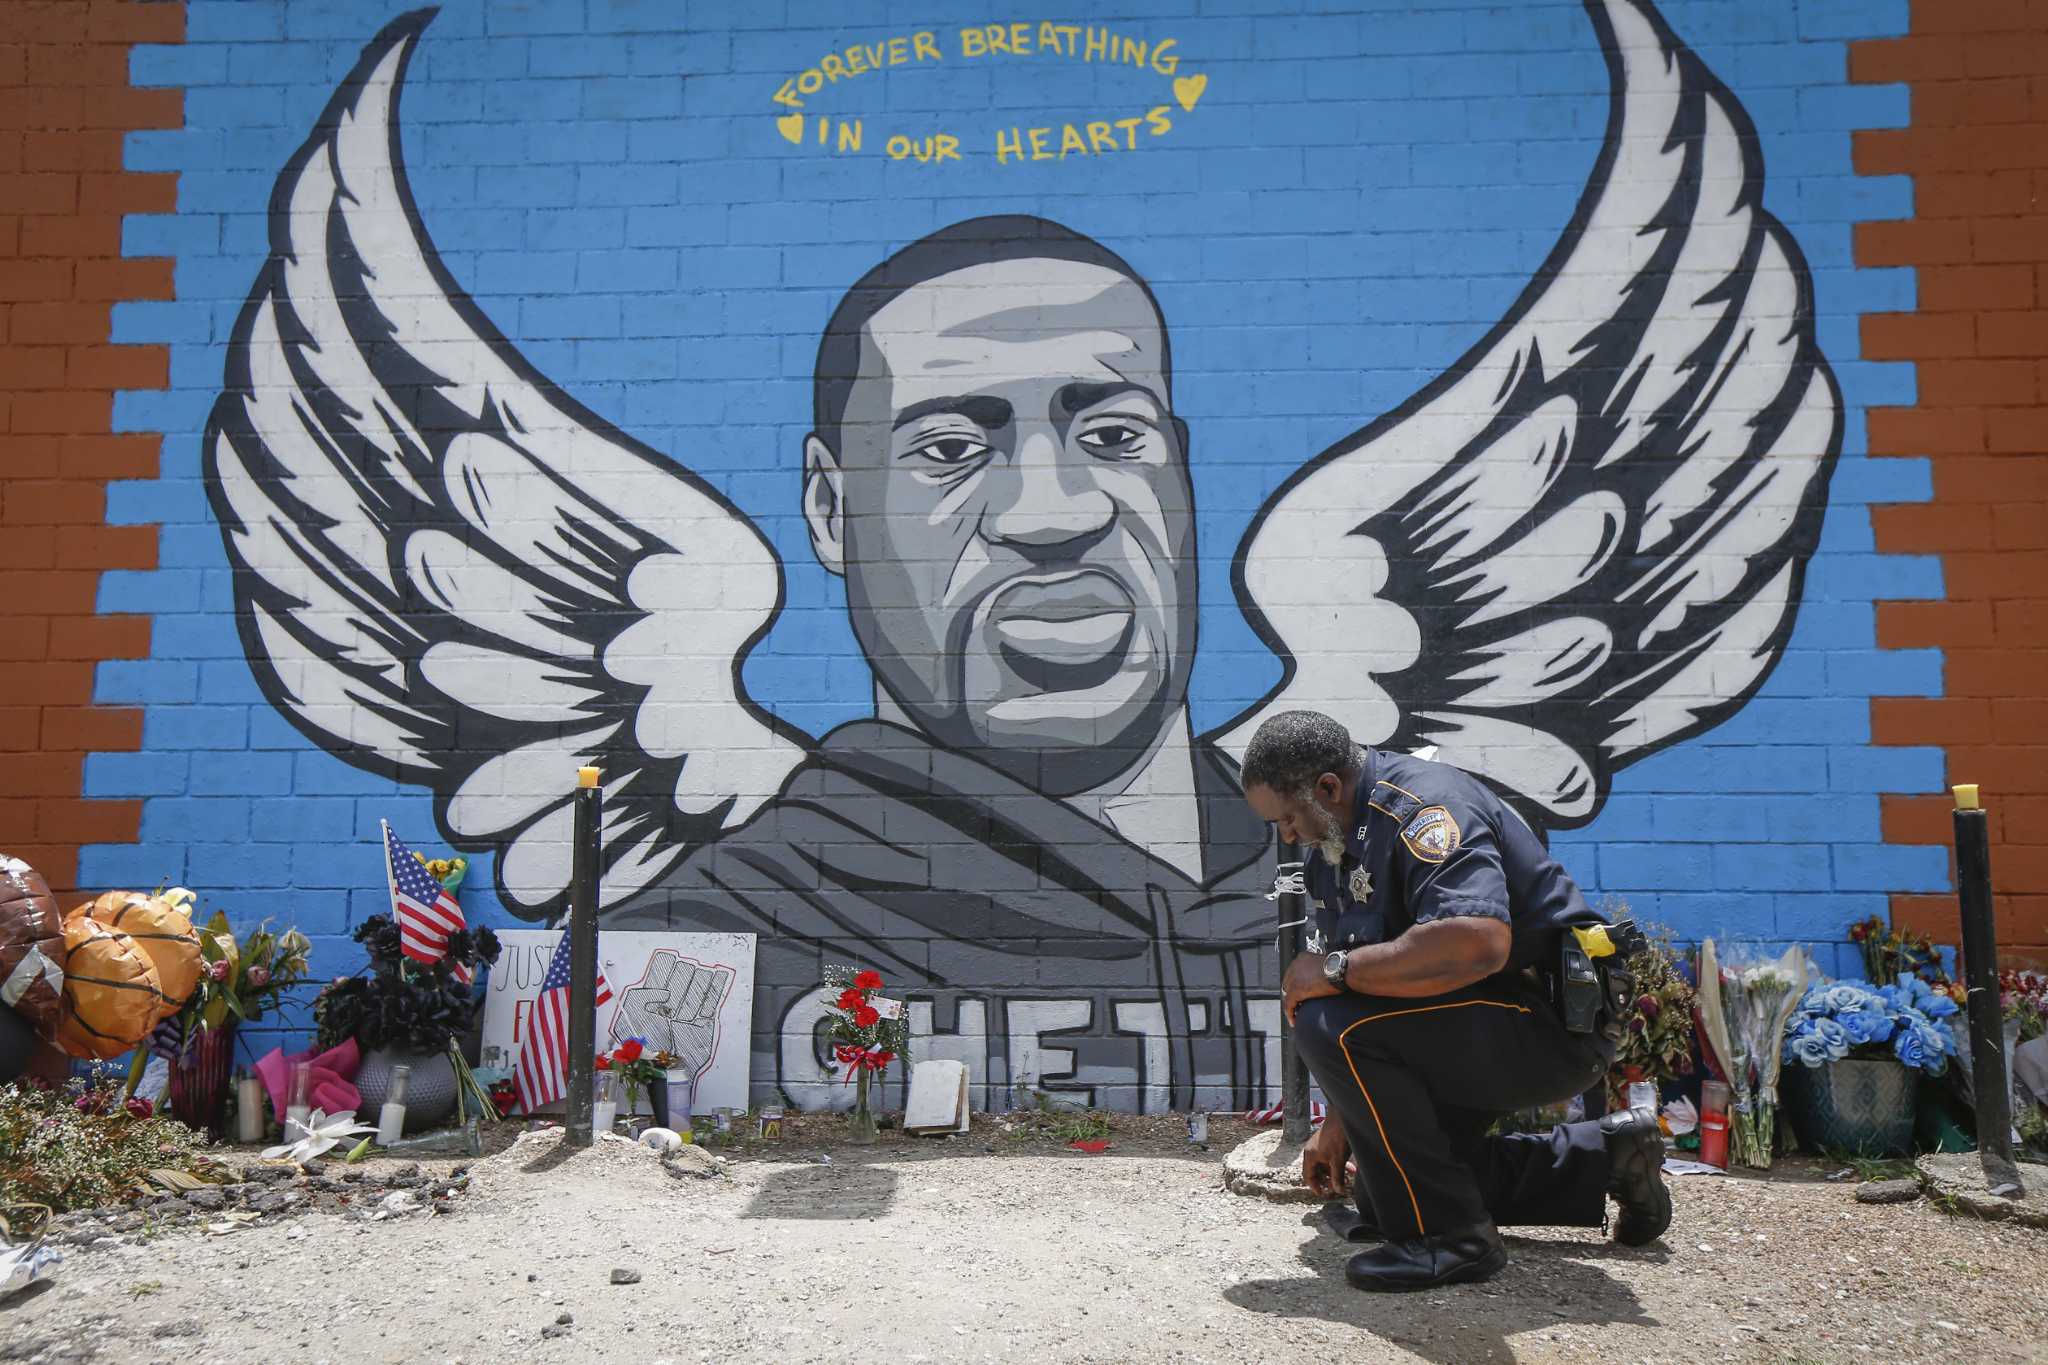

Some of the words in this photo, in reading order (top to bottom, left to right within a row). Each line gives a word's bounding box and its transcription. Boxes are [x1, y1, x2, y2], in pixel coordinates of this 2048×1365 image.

[773, 31, 941, 107] FOREVER
[961, 21, 1180, 75] BREATHING
[818, 117, 862, 152] IN
[886, 134, 961, 162] OUR
[997, 106, 1172, 163] HEARTS
